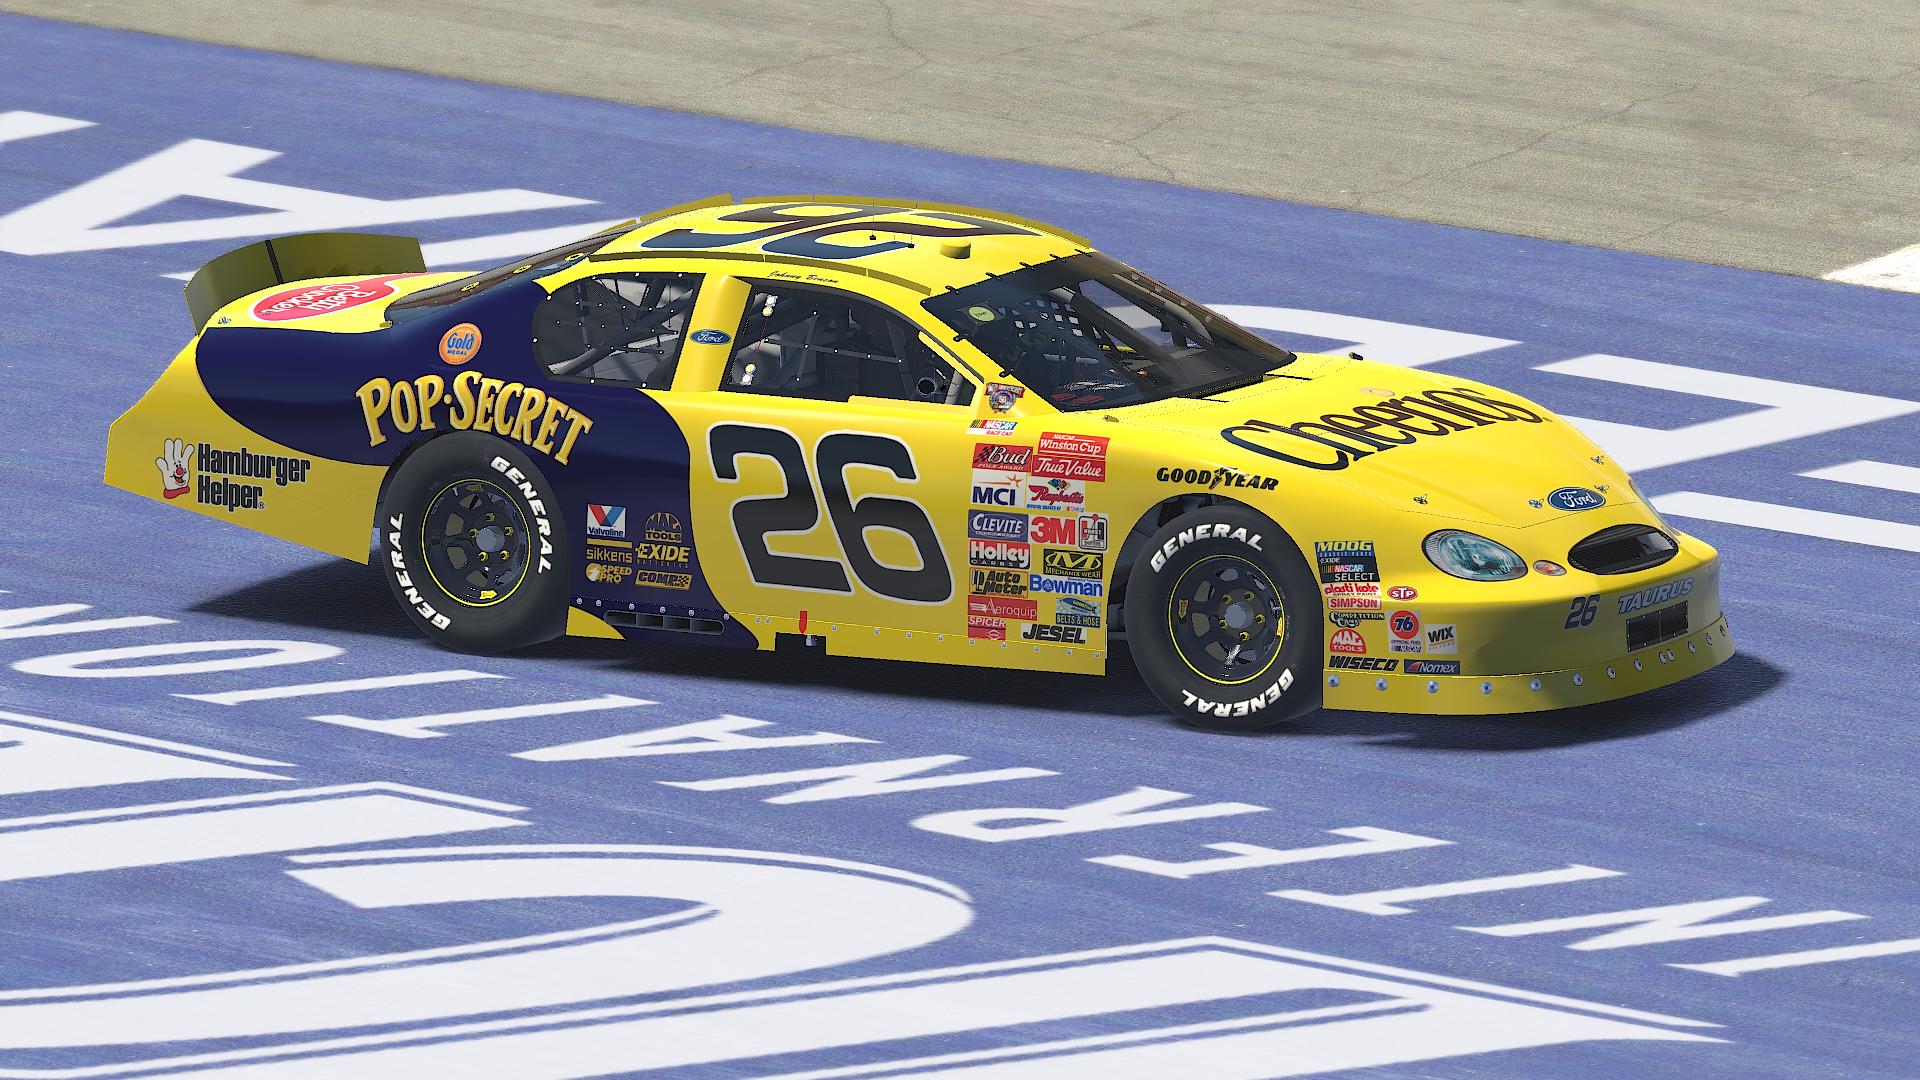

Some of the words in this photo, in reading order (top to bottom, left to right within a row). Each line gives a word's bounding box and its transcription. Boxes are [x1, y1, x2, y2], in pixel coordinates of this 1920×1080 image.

[447, 332, 474, 350] Gold
[697, 331, 723, 343] Ford
[984, 420, 1016, 430] NASCAR
[1221, 388, 1545, 471] Cheerios
[1040, 439, 1079, 452] Winston
[1080, 443, 1101, 456] Cup
[988, 446, 1031, 465] Bud
[197, 443, 311, 487] Hamburger
[972, 486, 1015, 506] MCI
[1559, 490, 1597, 508] Ford
[490, 456, 553, 574] GENERAL
[707, 421, 955, 606] 26
[972, 513, 1023, 534] CLEVITE
[1030, 515, 1076, 545] 3M
[588, 526, 624, 537] Valvoline
[647, 532, 681, 541] TOOLS
[635, 543, 690, 562] EXIDE
[970, 540, 1029, 568] Holley
[1150, 523, 1264, 574] GENERAL
[1317, 541, 1372, 552] MOOG
[586, 548, 632, 563] sikkens
[971, 559, 1013, 567] CARBS
[389, 513, 451, 630] GENERAL
[600, 565, 632, 576] SPEED
[1045, 567, 1080, 577] MECHANIX
[1081, 569, 1101, 578] WEAR
[1334, 564, 1364, 572] NASCAR
[600, 573, 622, 584] PRO
[639, 572, 678, 584] COMP
[986, 571, 1021, 583] Auto
[1335, 573, 1375, 581] SELECT
[983, 582, 1027, 595] Meter
[1030, 574, 1102, 596] Bowman
[1324, 583, 1353, 595] plasti
[1354, 583, 1379, 593] kote
[1391, 587, 1414, 599] STP
[1618, 577, 1695, 614] TAURUS
[985, 598, 1037, 618] Aeroquip
[1330, 598, 1378, 608] SIMPSON
[1056, 613, 1075, 624] BELTS
[1077, 616, 1082, 625] &
[1083, 616, 1100, 626] HOSE
[1330, 611, 1384, 623] COMPETITION
[1564, 594, 1600, 630] 26
[968, 616, 1006, 627] SPICER
[1338, 618, 1359, 628] CAMS
[1394, 616, 1414, 632] 76
[1023, 624, 1085, 644] JESEL
[1428, 626, 1454, 643] WIX
[1329, 656, 1399, 671] WISECO
[1420, 662, 1456, 673] Nomex
[1182, 668, 1295, 718] GENERAL
